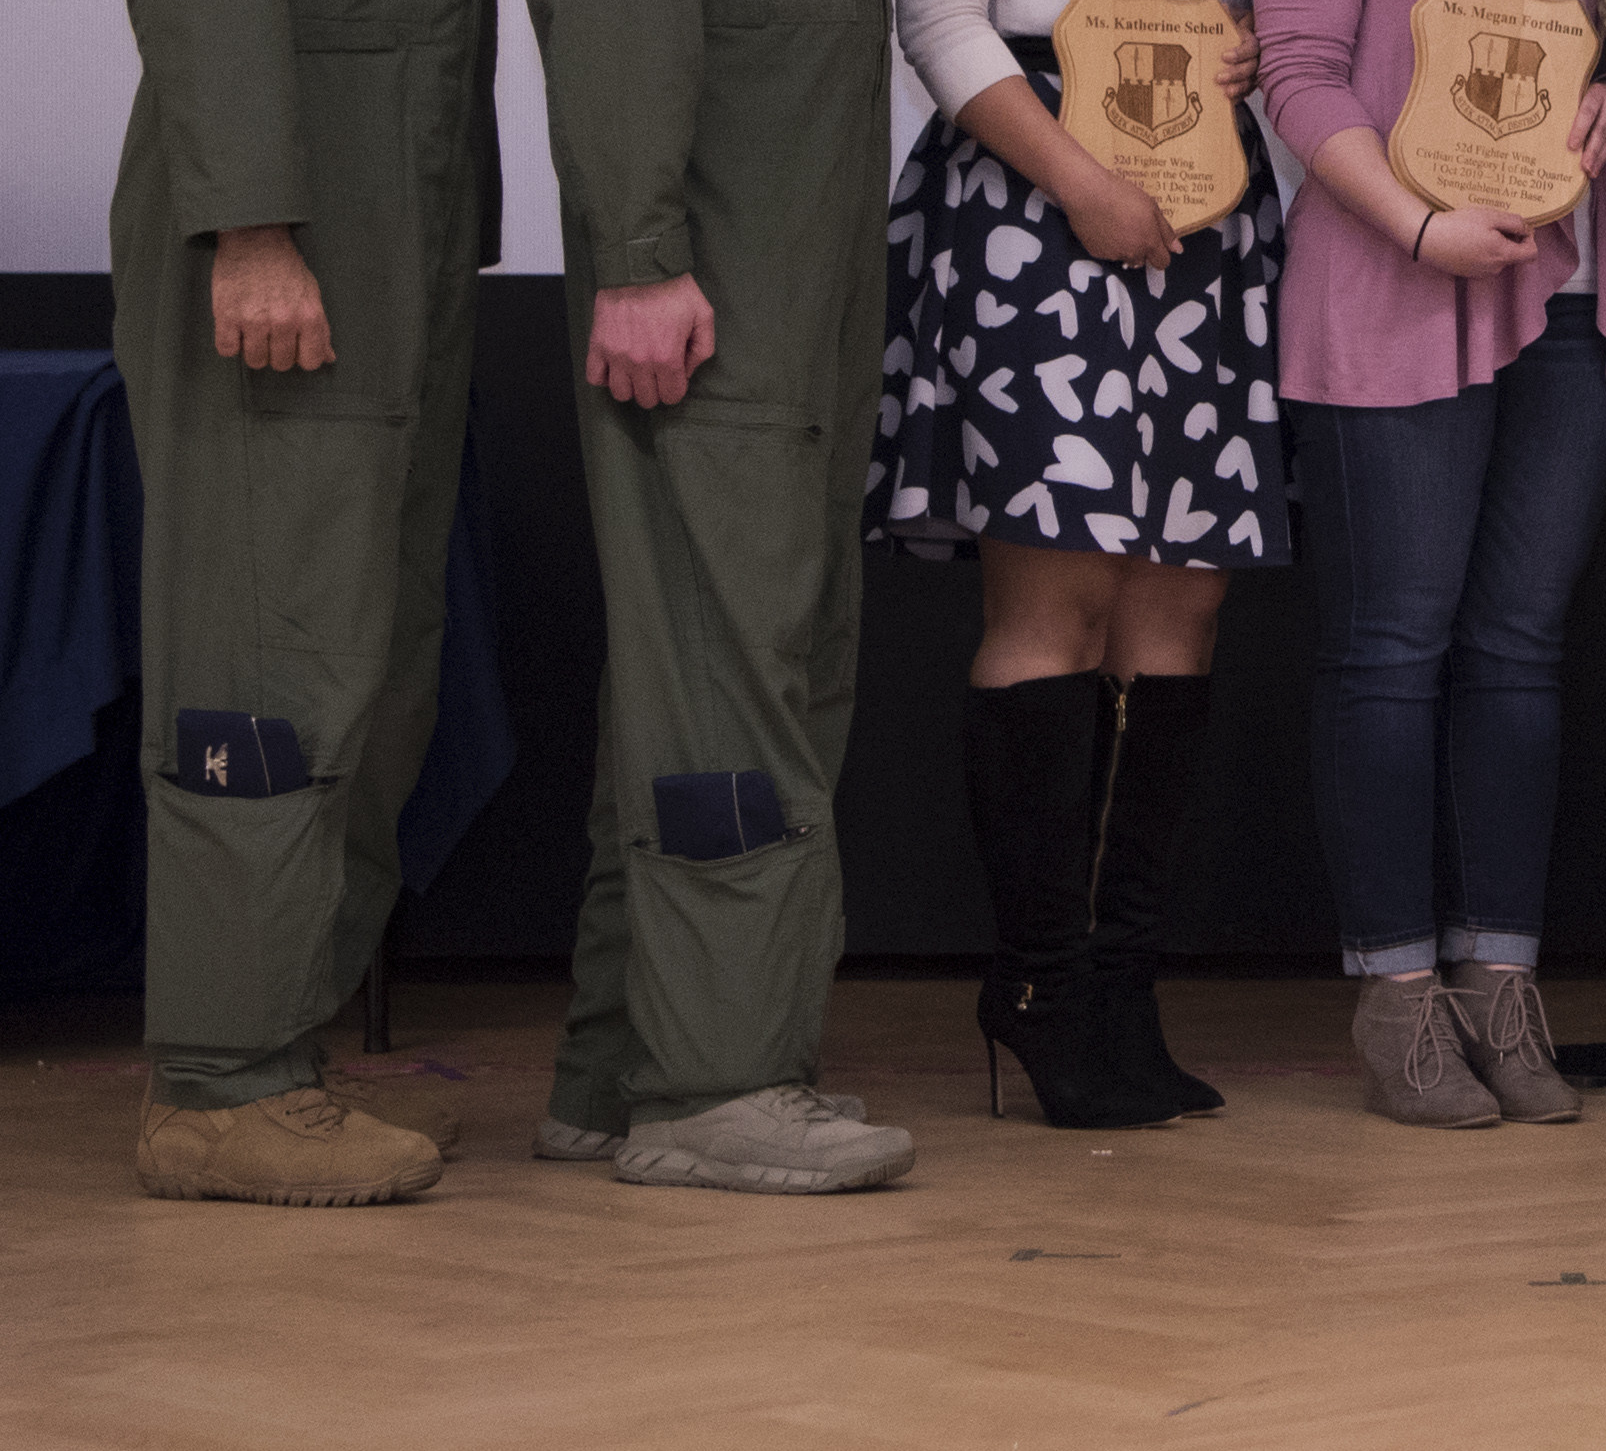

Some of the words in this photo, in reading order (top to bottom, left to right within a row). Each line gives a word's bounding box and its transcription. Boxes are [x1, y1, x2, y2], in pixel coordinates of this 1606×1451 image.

[1086, 16, 1108, 28] Ms.
[1115, 18, 1180, 33] Katherine
[1185, 22, 1224, 34] Schell
[1443, 1, 1466, 15] Ms.
[1472, 6, 1517, 26] Megan
[1521, 15, 1583, 37] Fordham
